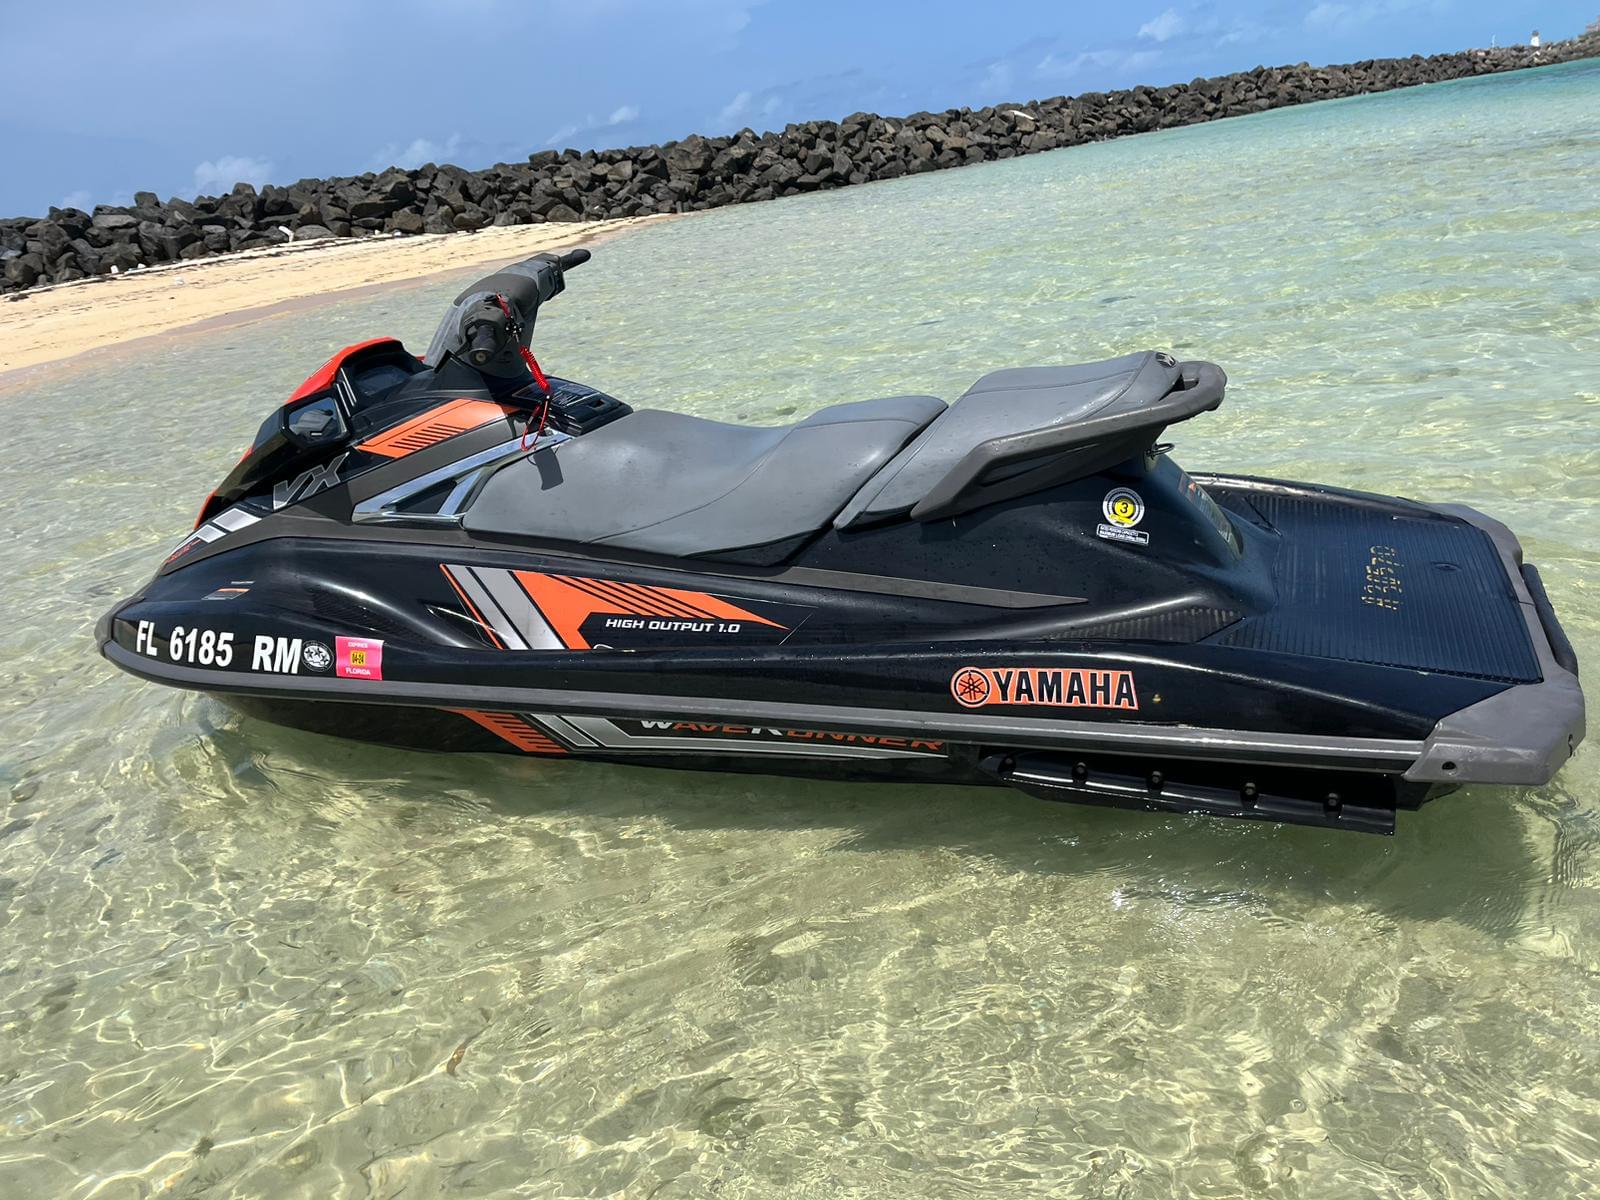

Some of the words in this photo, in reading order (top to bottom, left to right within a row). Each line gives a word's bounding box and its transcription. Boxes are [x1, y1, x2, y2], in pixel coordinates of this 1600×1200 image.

[273, 451, 350, 511] VX
[1119, 502, 1129, 514] 3
[605, 618, 646, 631] HIGH
[648, 620, 716, 633] OUTPUT
[718, 623, 741, 634] 1.0
[136, 620, 158, 657] FL
[169, 626, 235, 668] 6185
[252, 635, 303, 675] RM
[345, 667, 371, 676] FLORIDA
[992, 670, 1136, 708] YAMAHA
